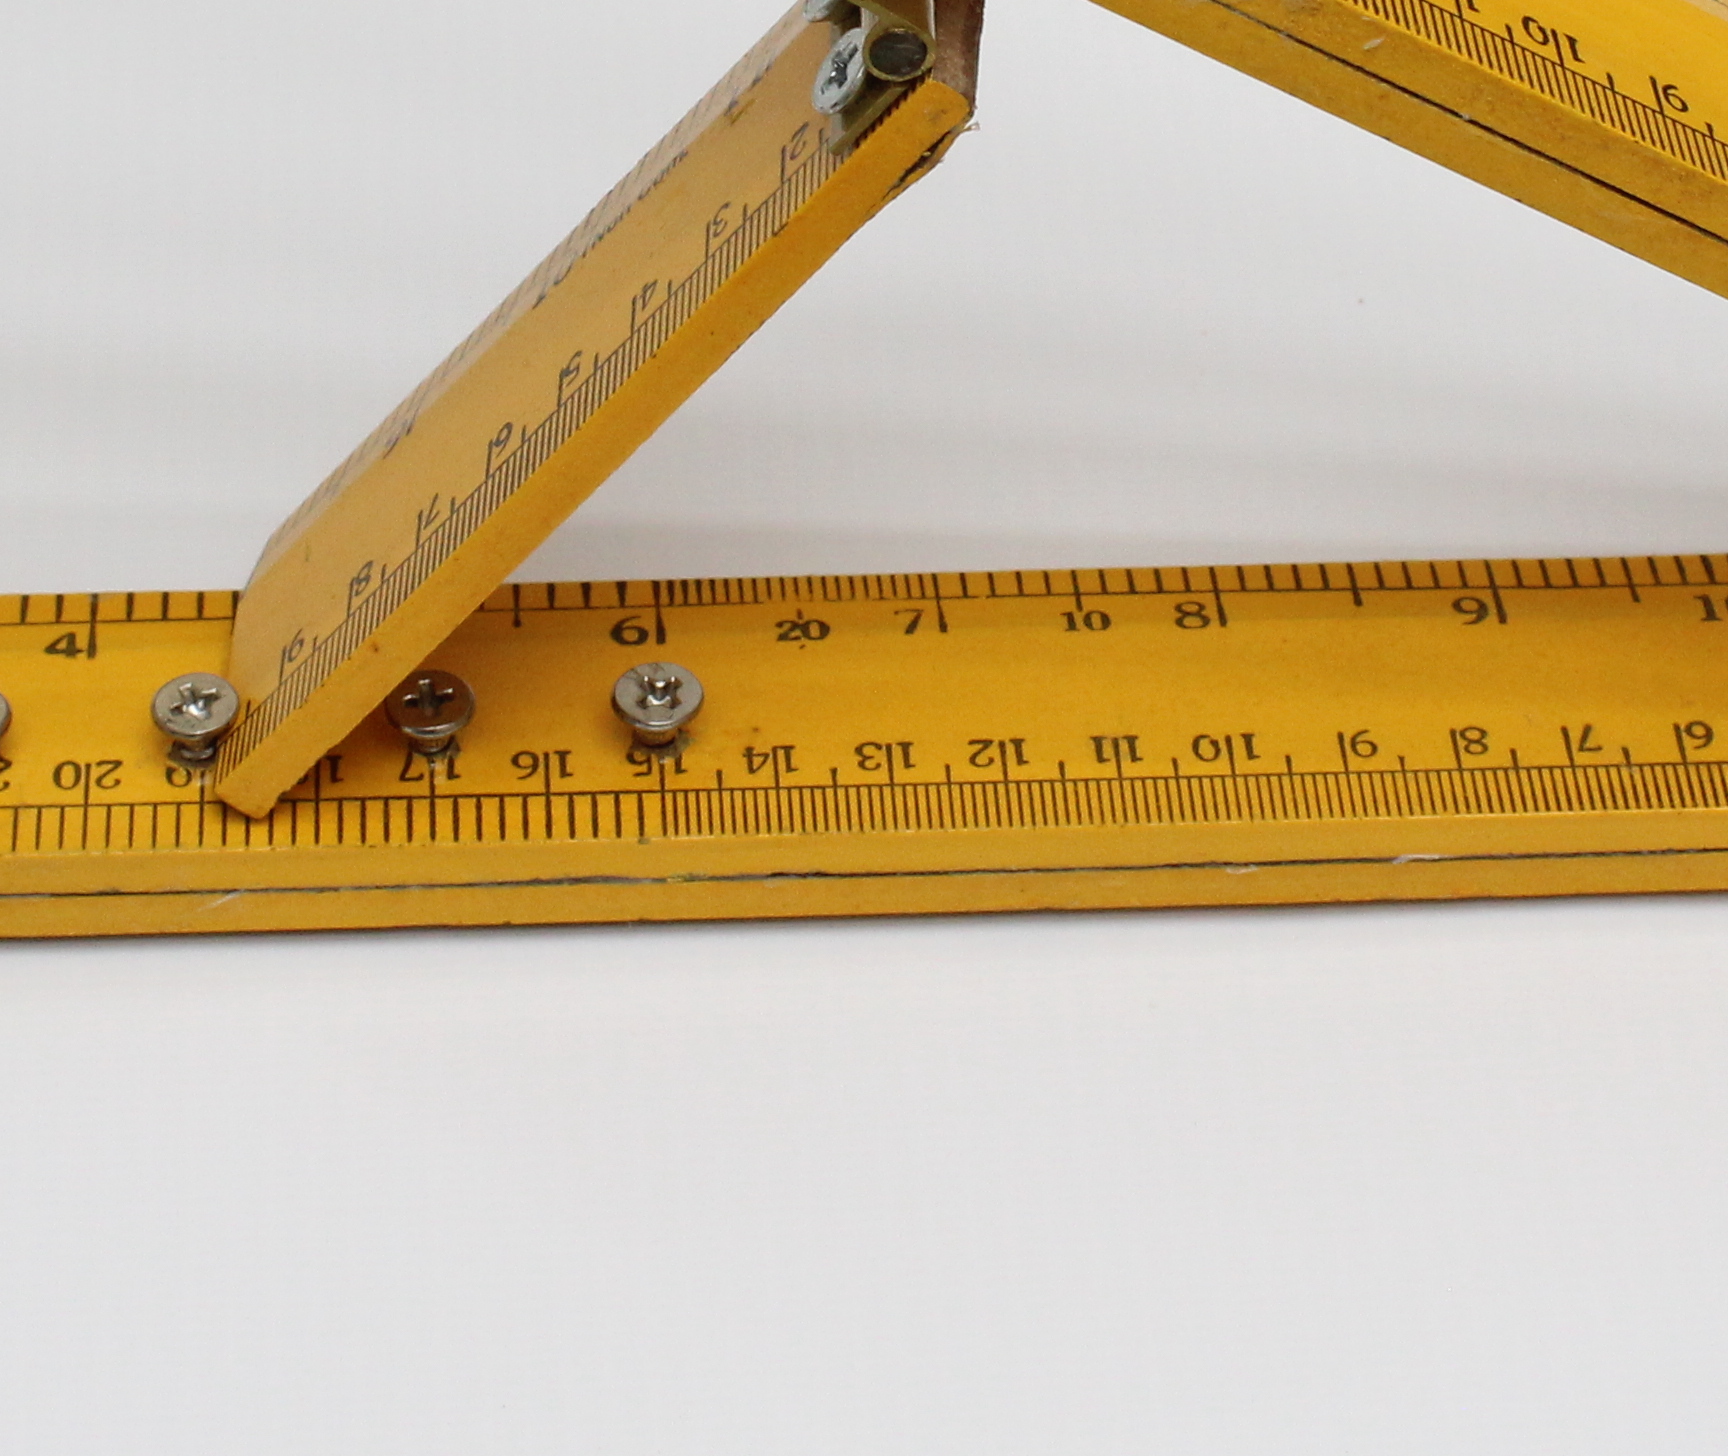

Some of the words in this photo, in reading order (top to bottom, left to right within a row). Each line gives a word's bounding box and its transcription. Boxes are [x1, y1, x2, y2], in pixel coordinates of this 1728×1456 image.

[43, 632, 84, 659] 4
[609, 616, 649, 647] 6
[774, 617, 831, 643] 20
[894, 609, 925, 635] 7
[1060, 610, 1112, 632] 10
[1173, 601, 1211, 630] 8
[1451, 596, 1490, 626] 9
[968, 737, 1031, 767] 12
[1459, 726, 1489, 755] 8
[1575, 723, 1603, 753] 7
[743, 744, 799, 775] 14
[855, 741, 917, 771] 13
[53, 760, 123, 790] 20
